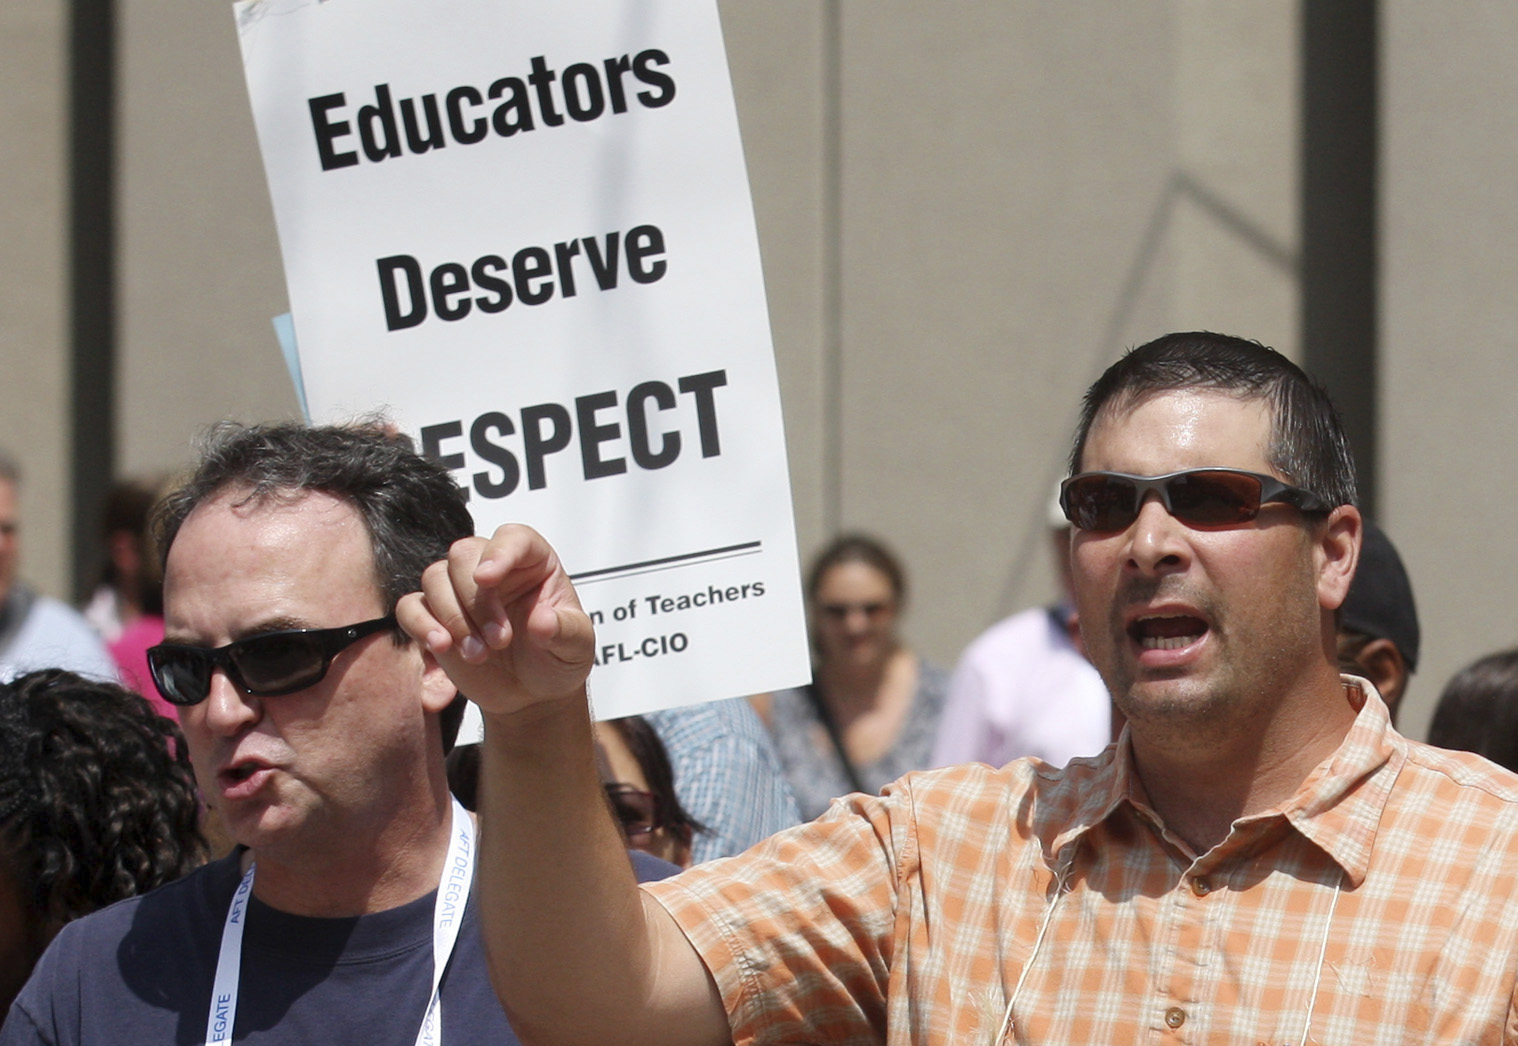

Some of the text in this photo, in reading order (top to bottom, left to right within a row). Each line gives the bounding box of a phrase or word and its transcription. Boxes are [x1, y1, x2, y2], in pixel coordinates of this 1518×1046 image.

[307, 48, 676, 172] Educators
[375, 222, 669, 333] Deserve
[418, 369, 728, 504] ESPECT
[613, 598, 637, 621] of
[644, 581, 766, 615] Teachers
[230, 900, 244, 924] AFT
[439, 856, 469, 929] DELEGATE
